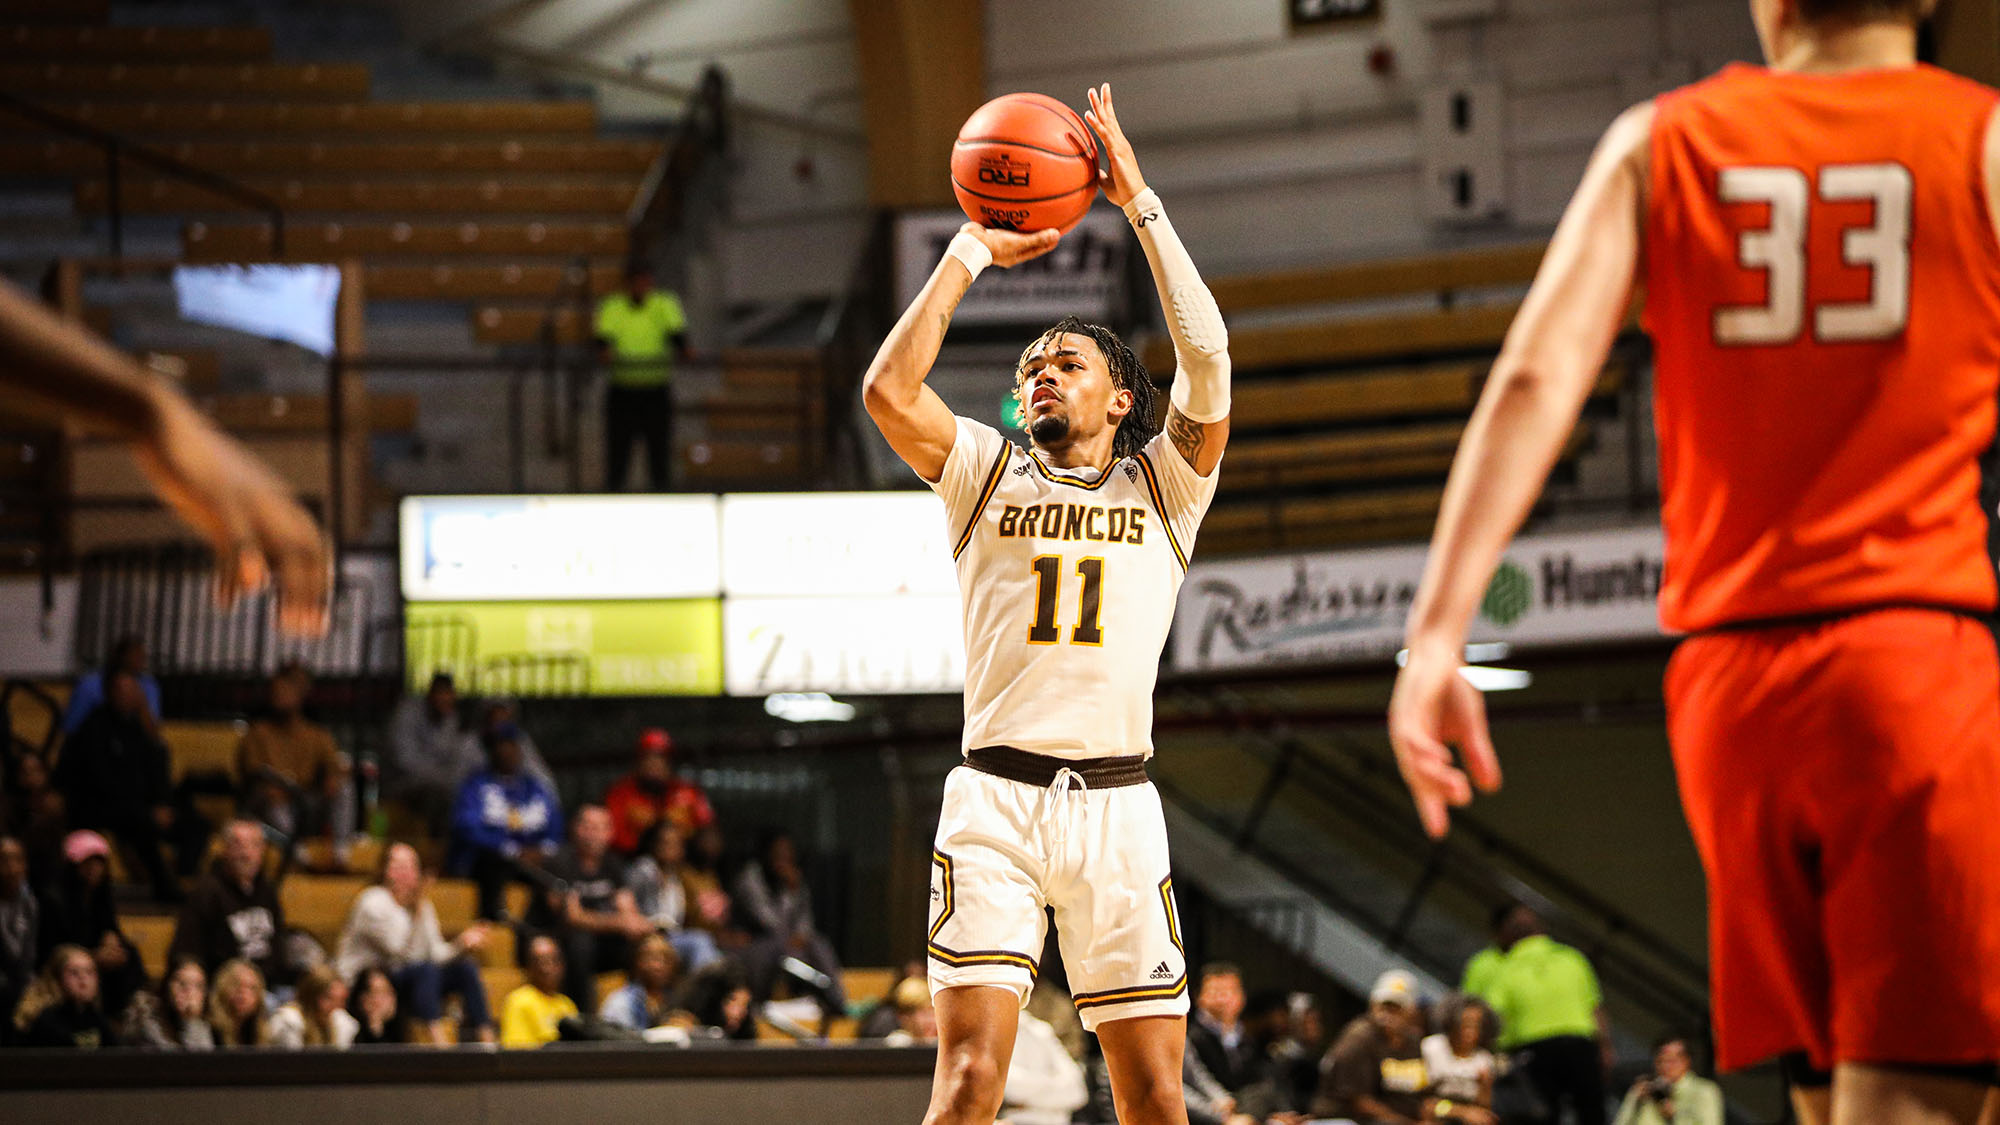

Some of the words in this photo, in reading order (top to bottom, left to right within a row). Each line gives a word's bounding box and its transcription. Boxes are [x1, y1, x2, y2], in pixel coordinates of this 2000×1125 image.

[979, 167, 1029, 187] PRO
[980, 204, 1030, 225] adidas
[1713, 159, 1913, 346] 33
[999, 503, 1146, 545] BRONCOS
[1026, 553, 1104, 647] 11
[1150, 972, 1174, 980] adidas
